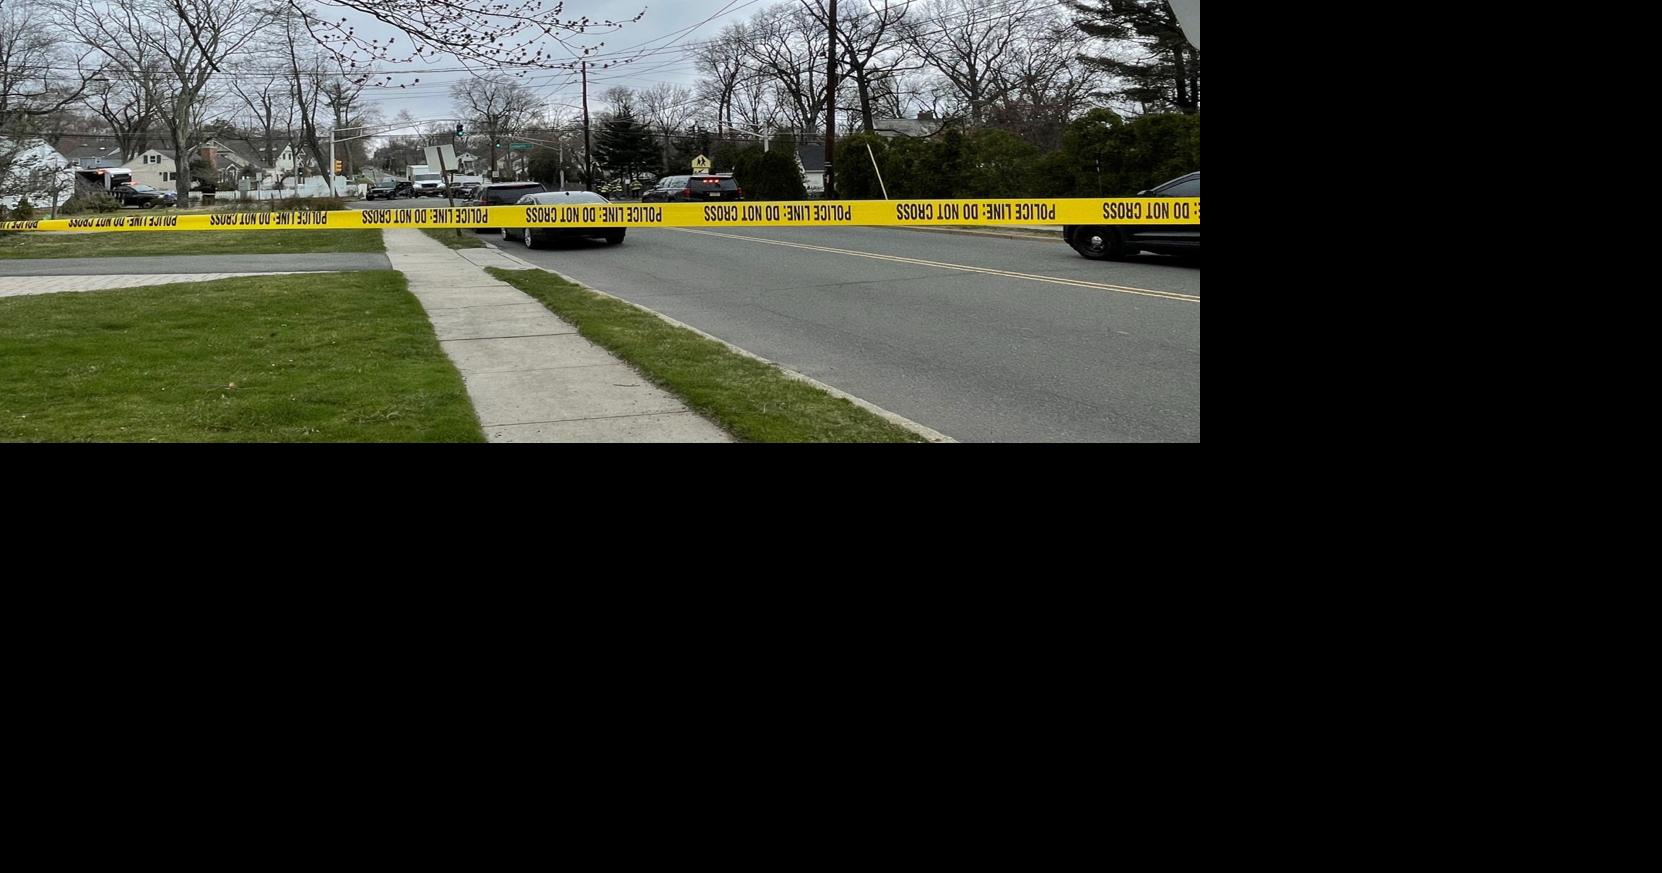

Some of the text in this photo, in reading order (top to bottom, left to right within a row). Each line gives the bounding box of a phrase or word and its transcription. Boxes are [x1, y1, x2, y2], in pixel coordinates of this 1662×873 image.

[210, 211, 328, 225] POLICE LINE: DO NOT CROSS
[362, 208, 488, 224] POLICE LINE: DO NOT CROSS
[525, 206, 662, 223] POLICE LINE: DO NOT CROSS
[703, 205, 852, 222] POLICE LINE: DO NOT CROSS
[897, 203, 1056, 221] POLICE LINE: DO NOT CROSS
[1102, 202, 1142, 220] CROSS
[1145, 202, 1170, 220] NOT
[1173, 202, 1190, 220] DO
